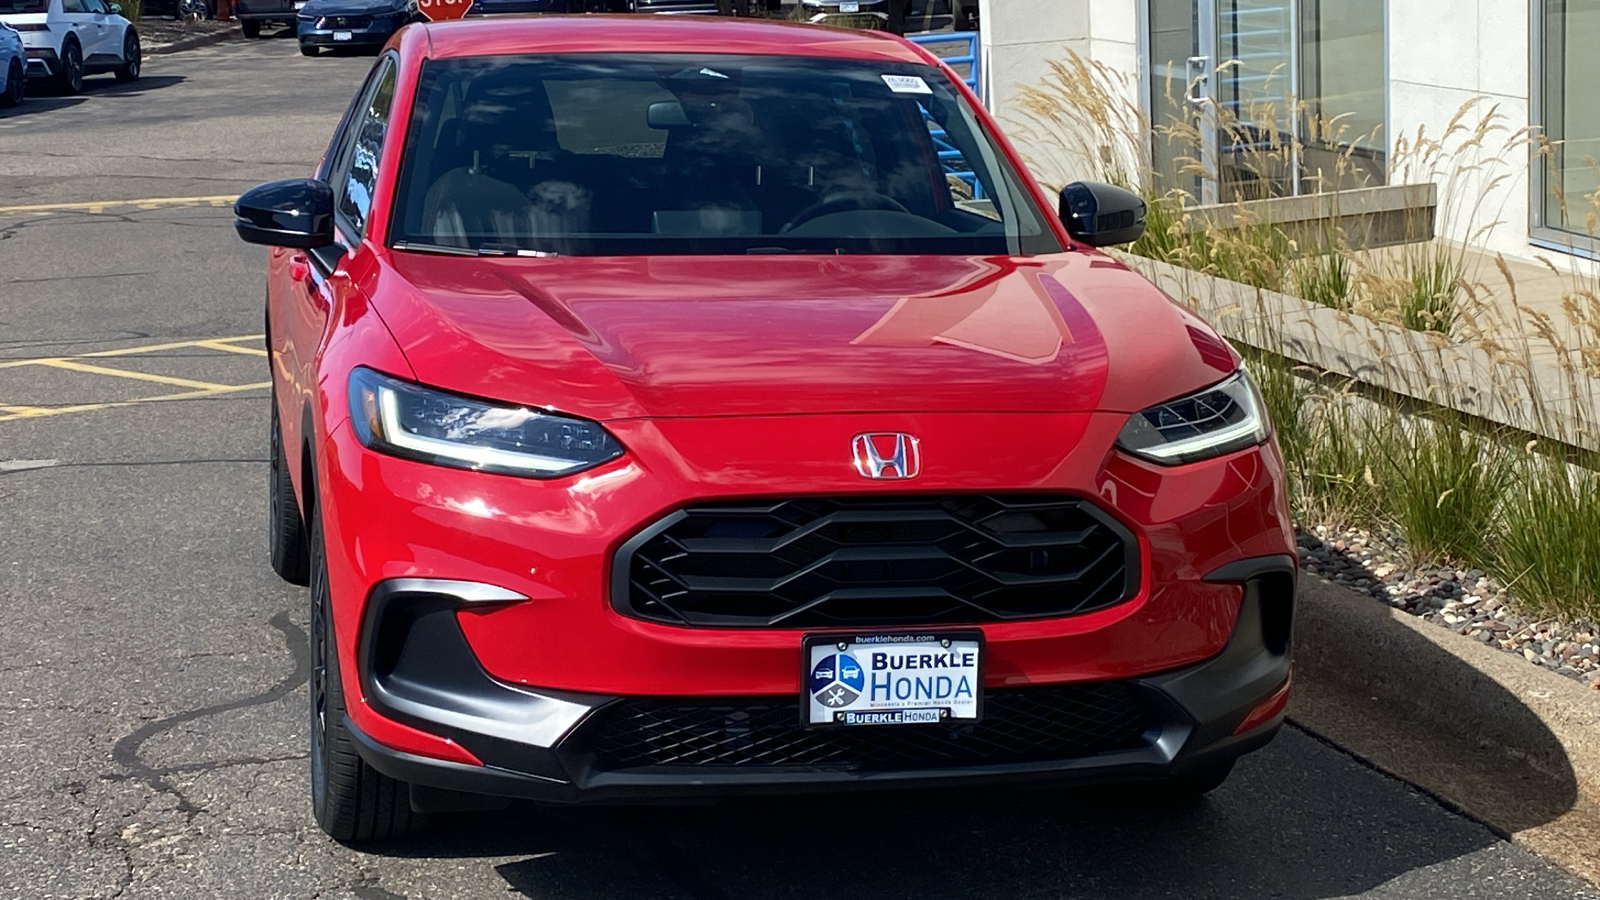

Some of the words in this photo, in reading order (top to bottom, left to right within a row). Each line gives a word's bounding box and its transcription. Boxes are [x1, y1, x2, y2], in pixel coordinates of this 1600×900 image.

[855, 635, 935, 644] buerklehonda.com
[871, 652, 975, 671] BUERKLE
[870, 671, 973, 702] HONDA
[846, 712, 903, 724] BUERKLE
[904, 710, 938, 722] HONDA
